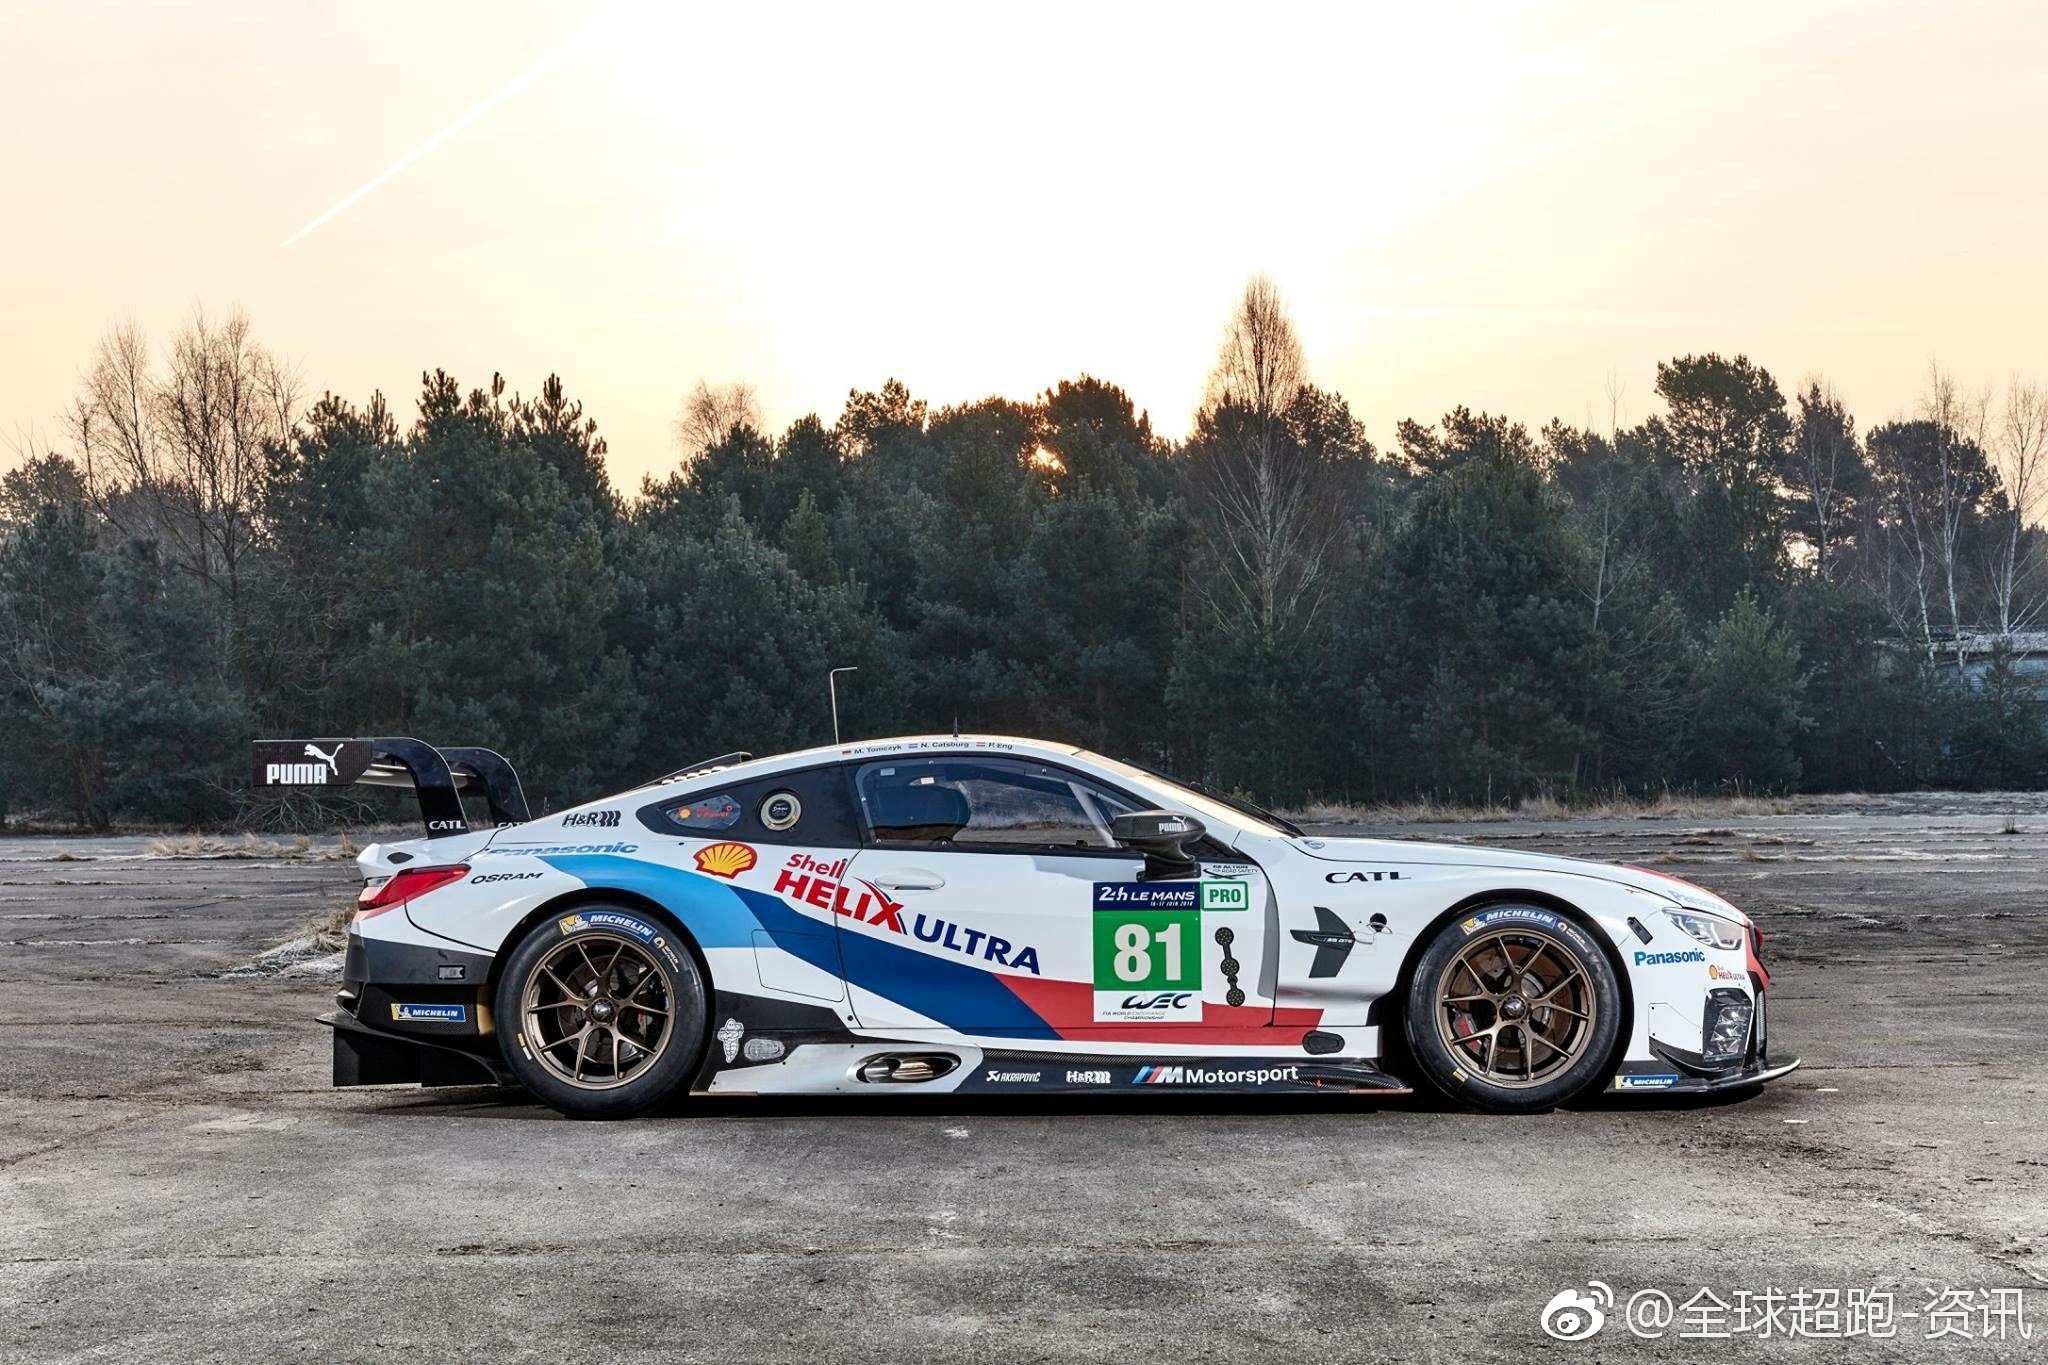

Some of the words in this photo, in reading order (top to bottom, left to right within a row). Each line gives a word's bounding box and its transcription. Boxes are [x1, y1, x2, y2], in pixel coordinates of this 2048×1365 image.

[866, 744, 902, 753] Tomczyk
[932, 741, 970, 749] Catsburg
[997, 742, 1013, 750] Eng
[266, 763, 327, 785] PUMA
[428, 820, 467, 830] CATL
[1158, 822, 1183, 834] PUMA
[488, 841, 640, 856] Panasonic
[786, 853, 848, 879] Shell
[470, 872, 545, 885] OSRAM
[1325, 871, 1412, 884] CATL
[1130, 892, 1149, 901] LE
[1151, 891, 1195, 901] MANS
[1209, 888, 1242, 902] PRO
[773, 869, 907, 936] HELIX
[913, 913, 1041, 976] ULTRA
[1486, 910, 1555, 924] MICHELIN
[590, 915, 654, 937] MICHELIN
[1113, 922, 1182, 983] 81
[1633, 947, 1706, 967] Panasonic
[1121, 992, 1193, 1009] WEC
[412, 1009, 458, 1017] MICHELIN
[1186, 1066, 1299, 1086] Motorsport
[1633, 1078, 1673, 1086] MICHELIN
